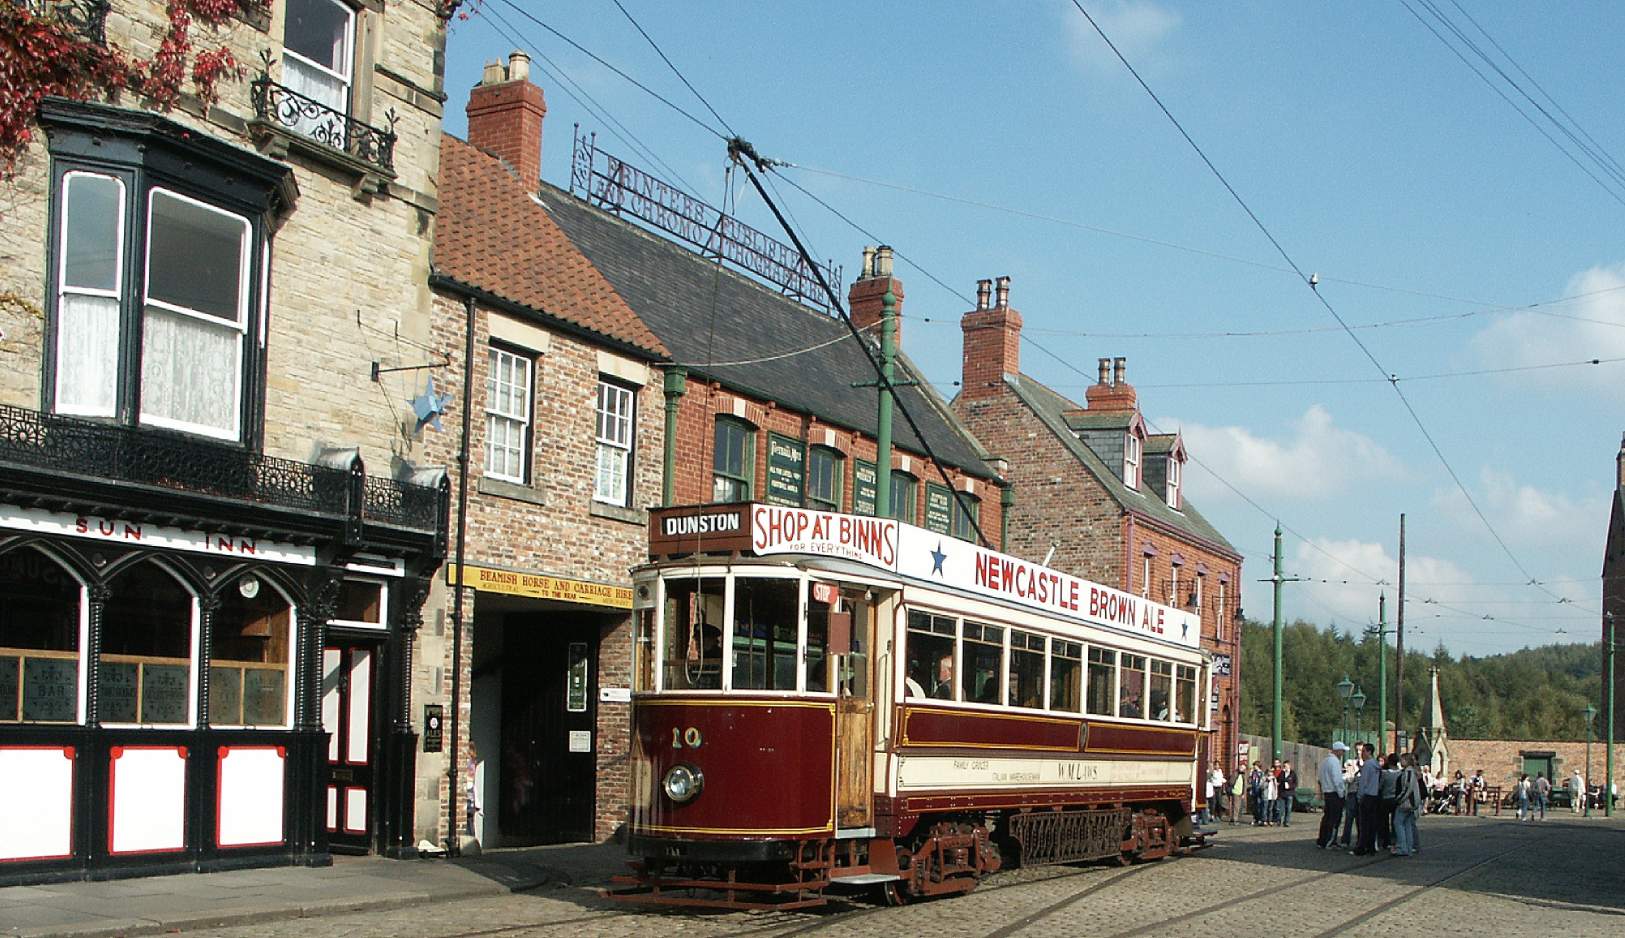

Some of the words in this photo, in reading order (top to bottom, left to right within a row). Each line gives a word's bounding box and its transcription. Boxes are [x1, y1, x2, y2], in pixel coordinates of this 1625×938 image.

[75, 518, 142, 541] SUN
[205, 535, 256, 555] INN
[666, 513, 739, 536] DUNSTON
[755, 508, 808, 549] SHOP
[811, 514, 832, 541] AT
[839, 516, 895, 566] BINNS
[789, 543, 806, 551] FOR
[479, 570, 518, 585] BEAMISH
[522, 576, 550, 589] HORSE
[555, 580, 570, 592] AND
[573, 583, 612, 598] CARRIAGE
[615, 588, 633, 600] HIRE
[975, 551, 1079, 611] NEWCASTLE
[1089, 587, 1136, 626] BROWN
[1142, 603, 1165, 634] ALE
[672, 727, 702, 749] 10
